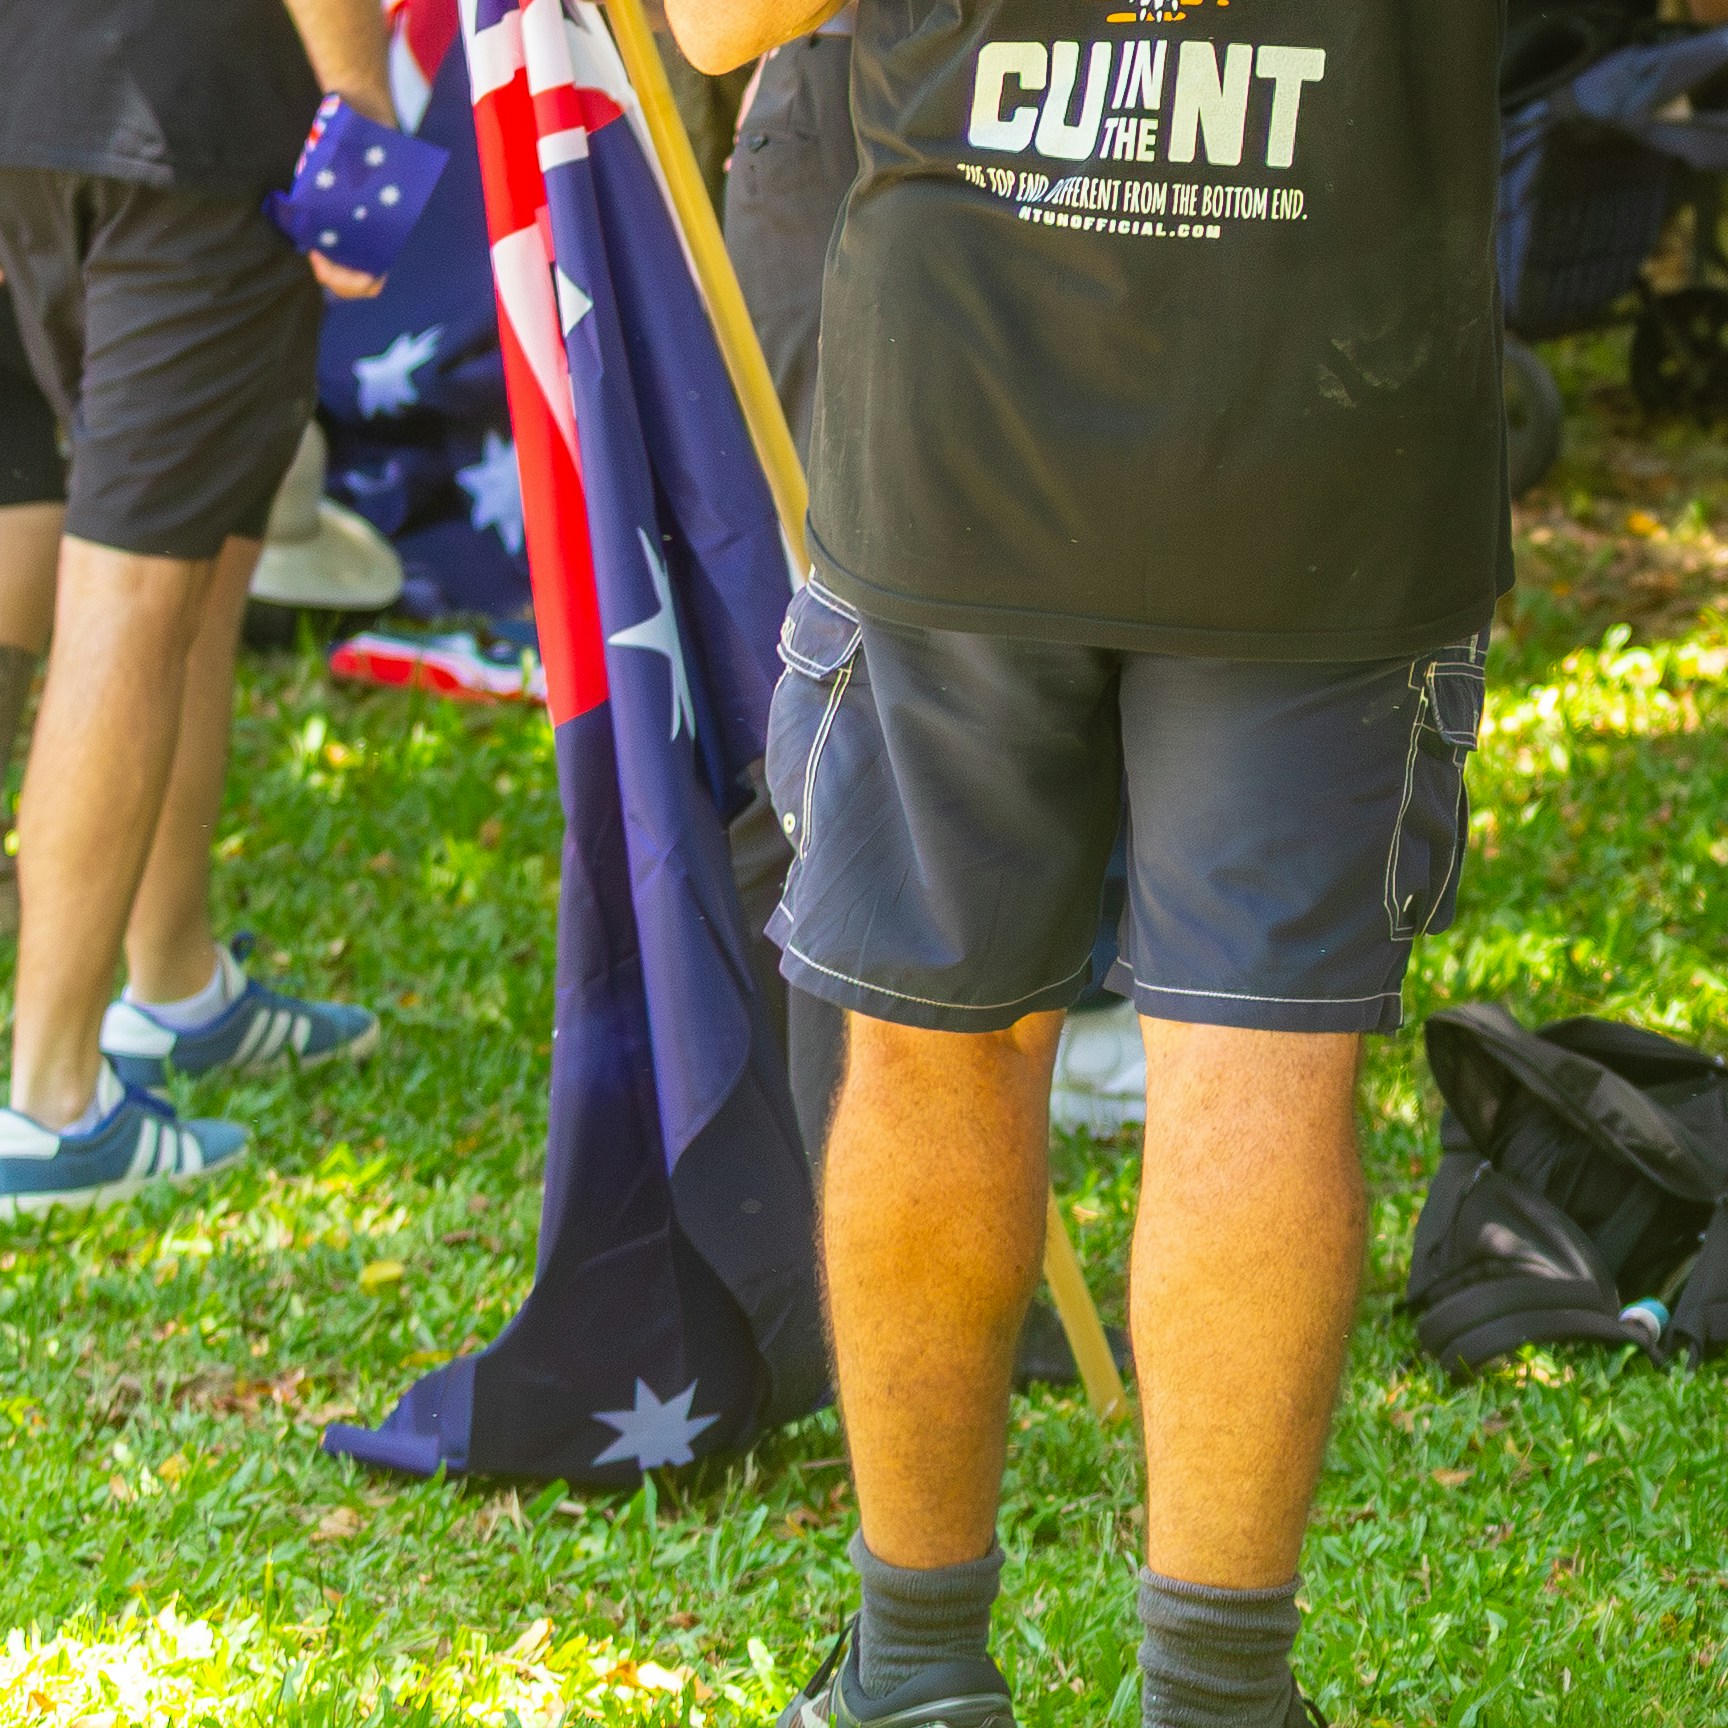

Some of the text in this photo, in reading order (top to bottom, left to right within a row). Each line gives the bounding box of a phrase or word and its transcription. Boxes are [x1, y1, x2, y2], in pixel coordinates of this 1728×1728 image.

[1111, 39, 1168, 110] IN
[1099, 116, 1160, 163] THE
[986, 168, 1016, 198] TOP
[1122, 180, 1168, 216] FROM
[1171, 184, 1199, 216] THE
[1201, 184, 1268, 221] BOTTOM
